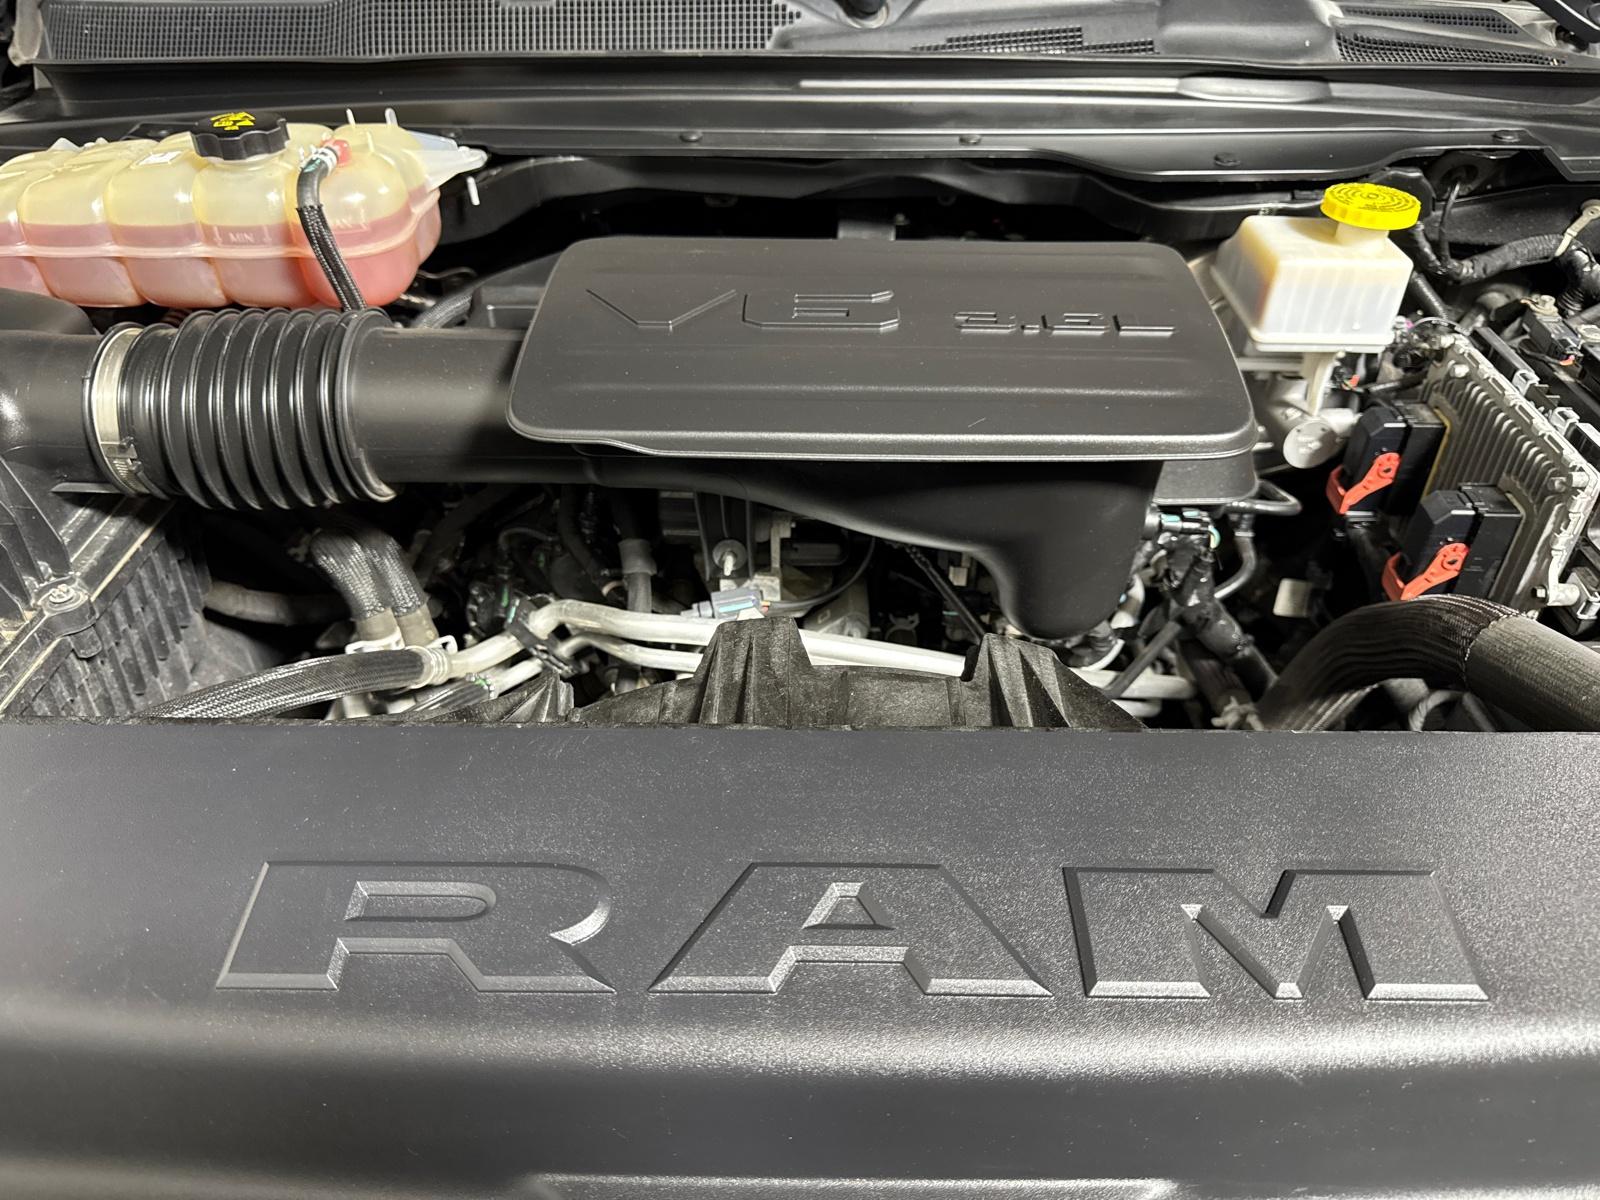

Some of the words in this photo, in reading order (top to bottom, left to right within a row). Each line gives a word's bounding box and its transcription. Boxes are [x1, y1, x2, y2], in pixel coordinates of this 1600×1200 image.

[228, 231, 255, 243] MIN
[585, 289, 900, 331] V6
[952, 310, 1178, 336] 3.6L
[215, 860, 1489, 1003] RAM
